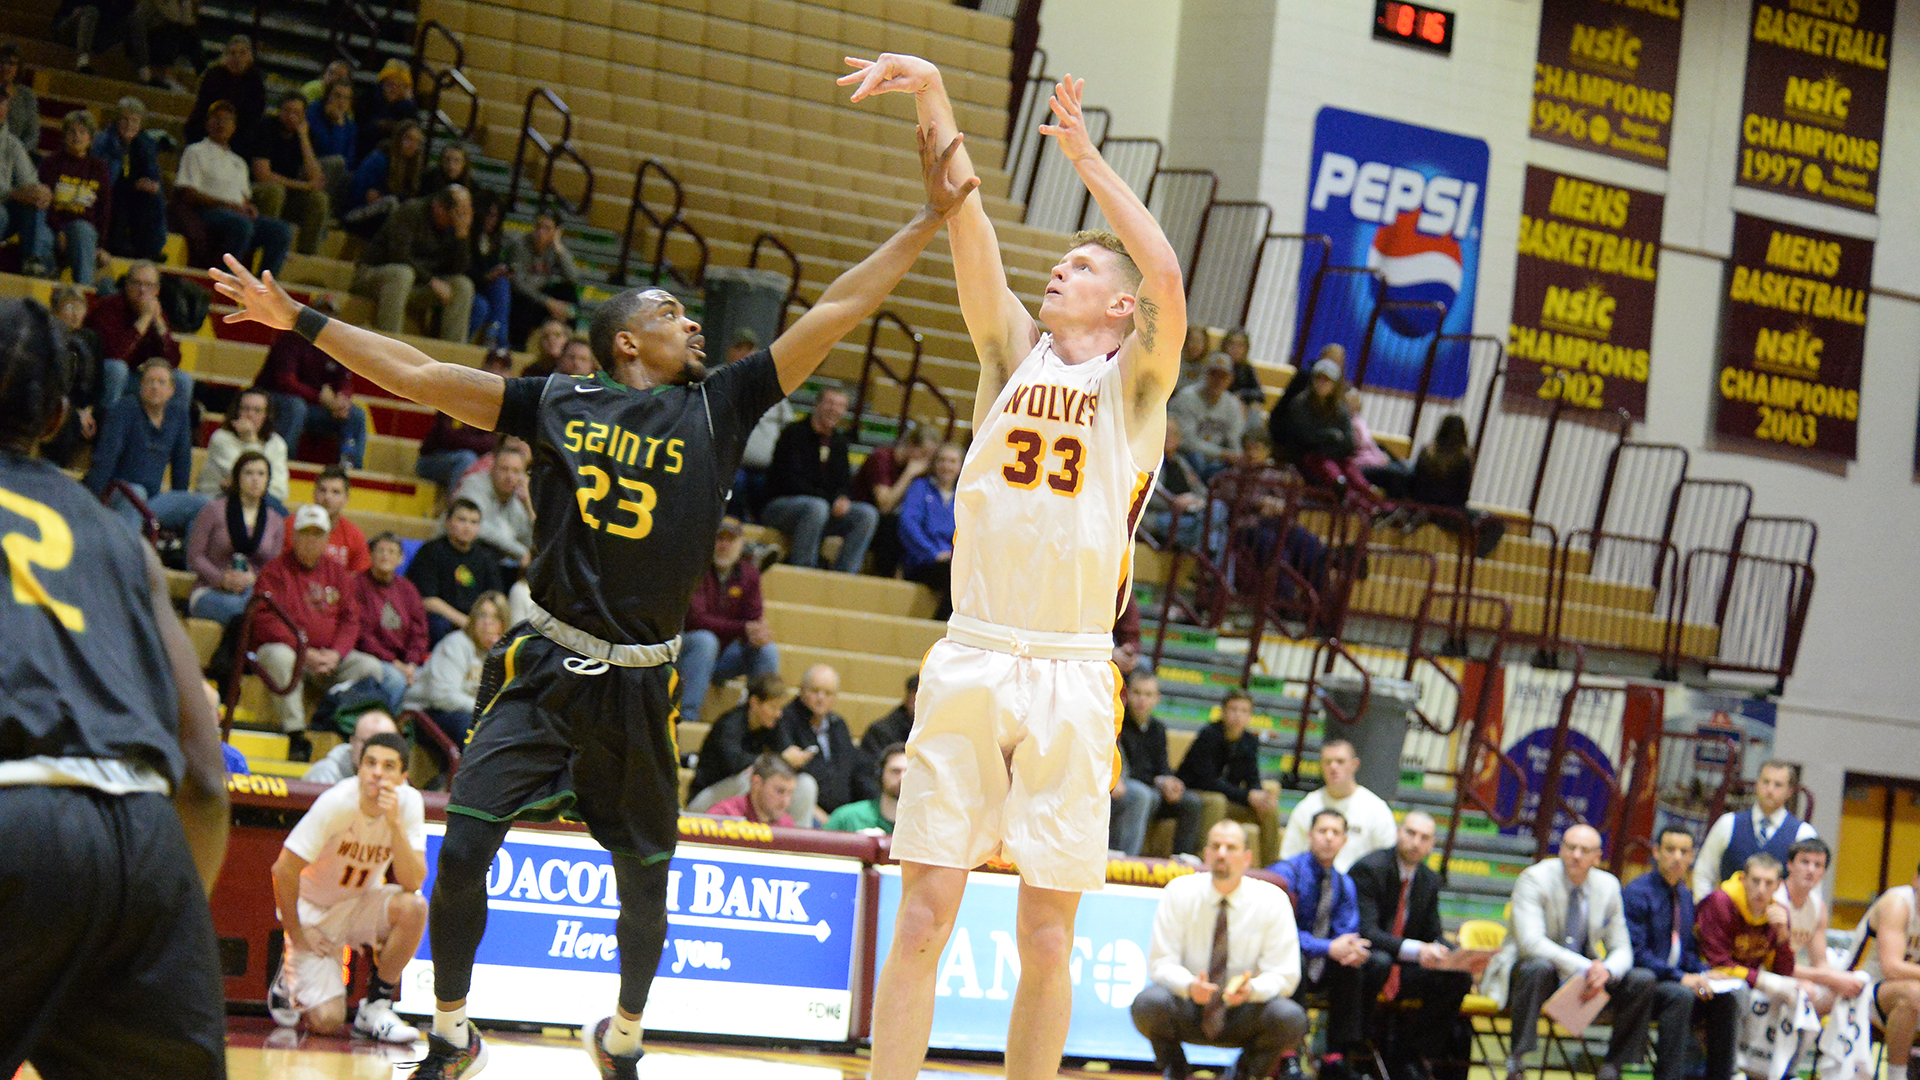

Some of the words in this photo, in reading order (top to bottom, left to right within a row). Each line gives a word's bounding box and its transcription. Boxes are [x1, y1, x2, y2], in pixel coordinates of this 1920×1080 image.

[1754, 5, 1887, 70] BASKETBALL
[1534, 63, 1672, 122] CHAMPIONS
[1742, 148, 1802, 188] 1997
[1743, 113, 1879, 171] CHAMPIONS
[1310, 152, 1479, 240] PEPSI
[1549, 177, 1630, 229] MENS
[1518, 214, 1657, 283] BASKETBALL
[1766, 231, 1842, 278] MENS
[1730, 266, 1867, 326] BASKETBALL
[1506, 324, 1650, 383] CHAMPIONS
[1537, 365, 1604, 409] 2002
[1719, 367, 1860, 421] CHAMPIONS
[1756, 407, 1818, 447] 2003
[1001, 426, 1087, 499] 33
[576, 465, 658, 540] 23
[0, 487, 85, 633] 2
[337, 841, 391, 863] WOLVES
[340, 865, 370, 887] 11
[689, 863, 811, 922] BANK
[548, 919, 619, 962] Here
[671, 938, 731, 974] you.
